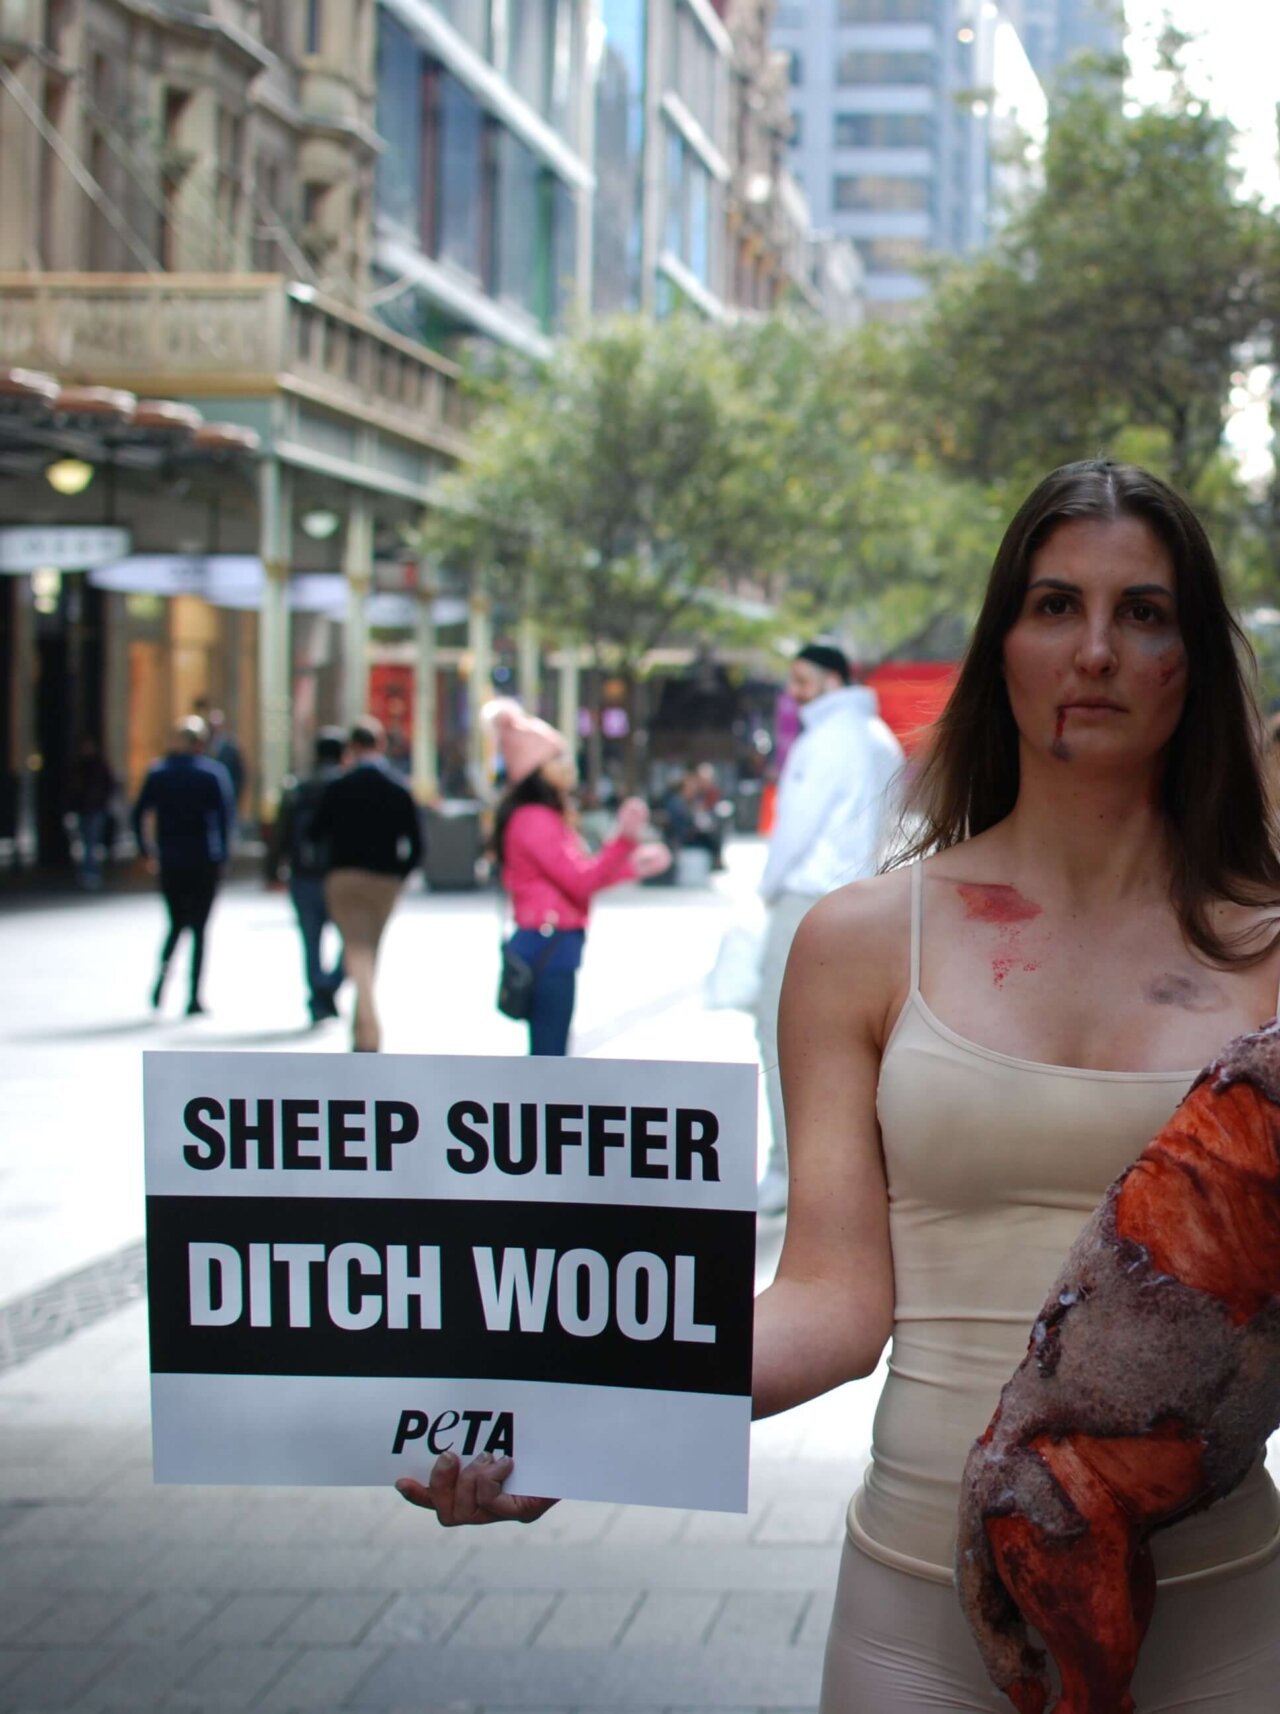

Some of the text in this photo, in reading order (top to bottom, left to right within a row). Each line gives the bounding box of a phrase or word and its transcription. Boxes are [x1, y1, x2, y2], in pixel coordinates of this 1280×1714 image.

[183, 1096, 721, 1182] SHEEP SUFFER
[188, 1241, 717, 1344] DITCH WOOL
